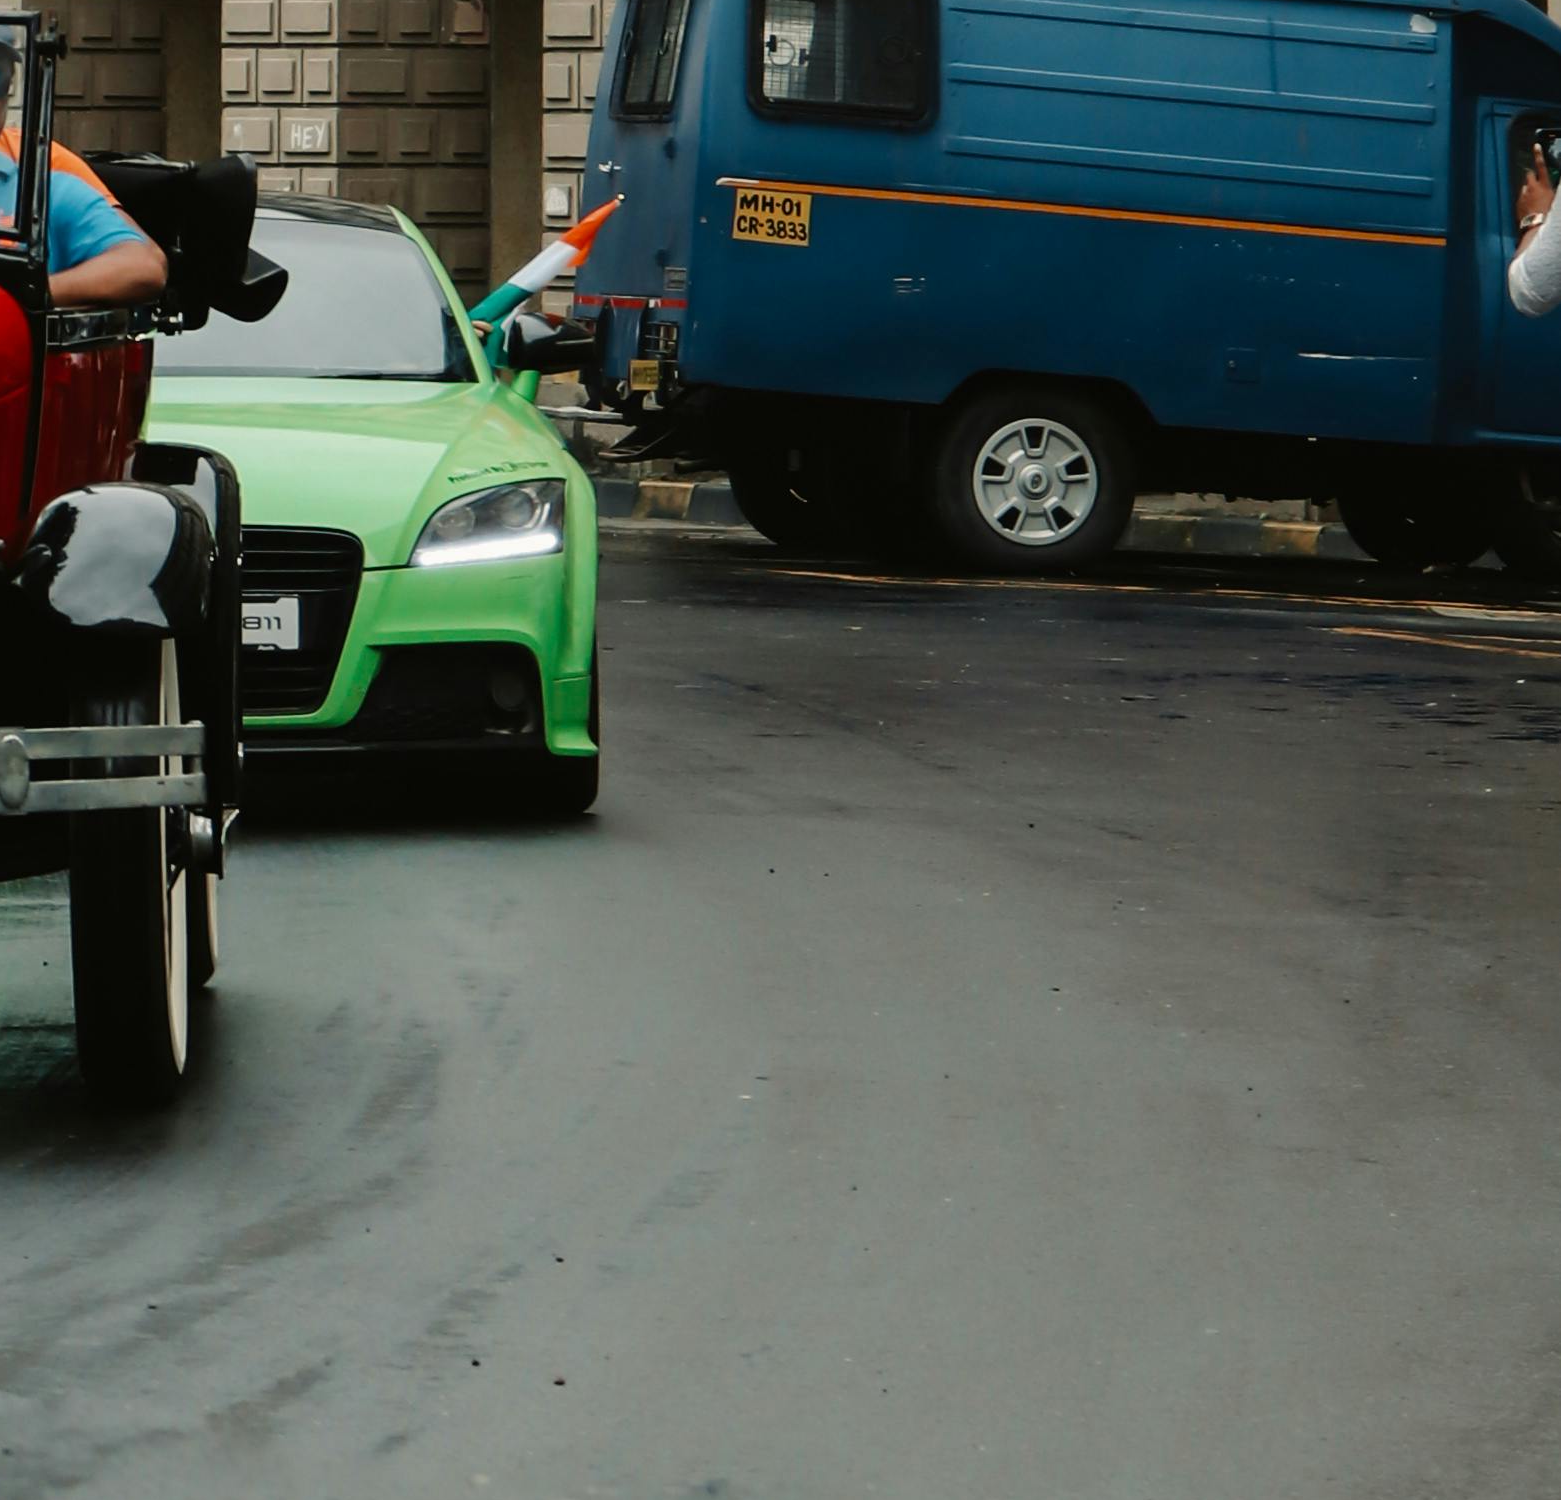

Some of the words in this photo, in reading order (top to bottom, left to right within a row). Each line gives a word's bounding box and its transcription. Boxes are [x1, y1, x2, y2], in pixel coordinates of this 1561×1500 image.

[291, 120, 326, 150] HEY
[740, 194, 802, 216] MH-01
[737, 215, 808, 241] CR-3833
